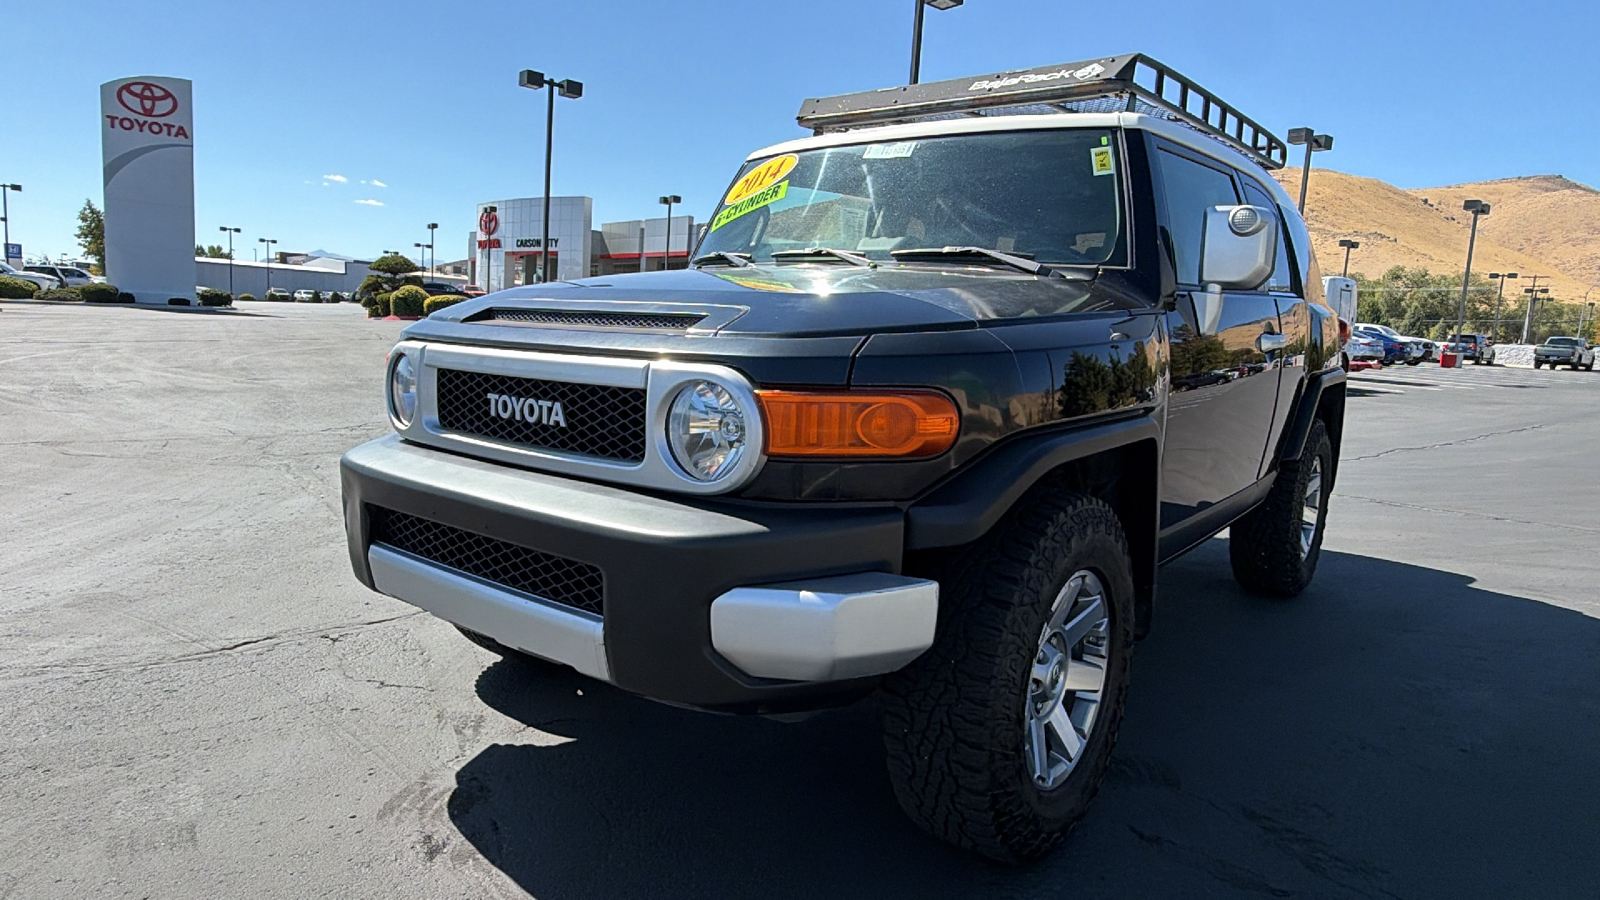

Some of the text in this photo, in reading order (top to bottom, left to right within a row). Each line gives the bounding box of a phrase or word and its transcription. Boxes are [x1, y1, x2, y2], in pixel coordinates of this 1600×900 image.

[968, 69, 1074, 91] BajaRack
[106, 114, 189, 139] TOYOTA
[732, 158, 787, 201] 2014
[714, 184, 783, 228] 6-CYLINDER
[516, 238, 541, 248] CARSON
[487, 393, 566, 427] TOYOTA
